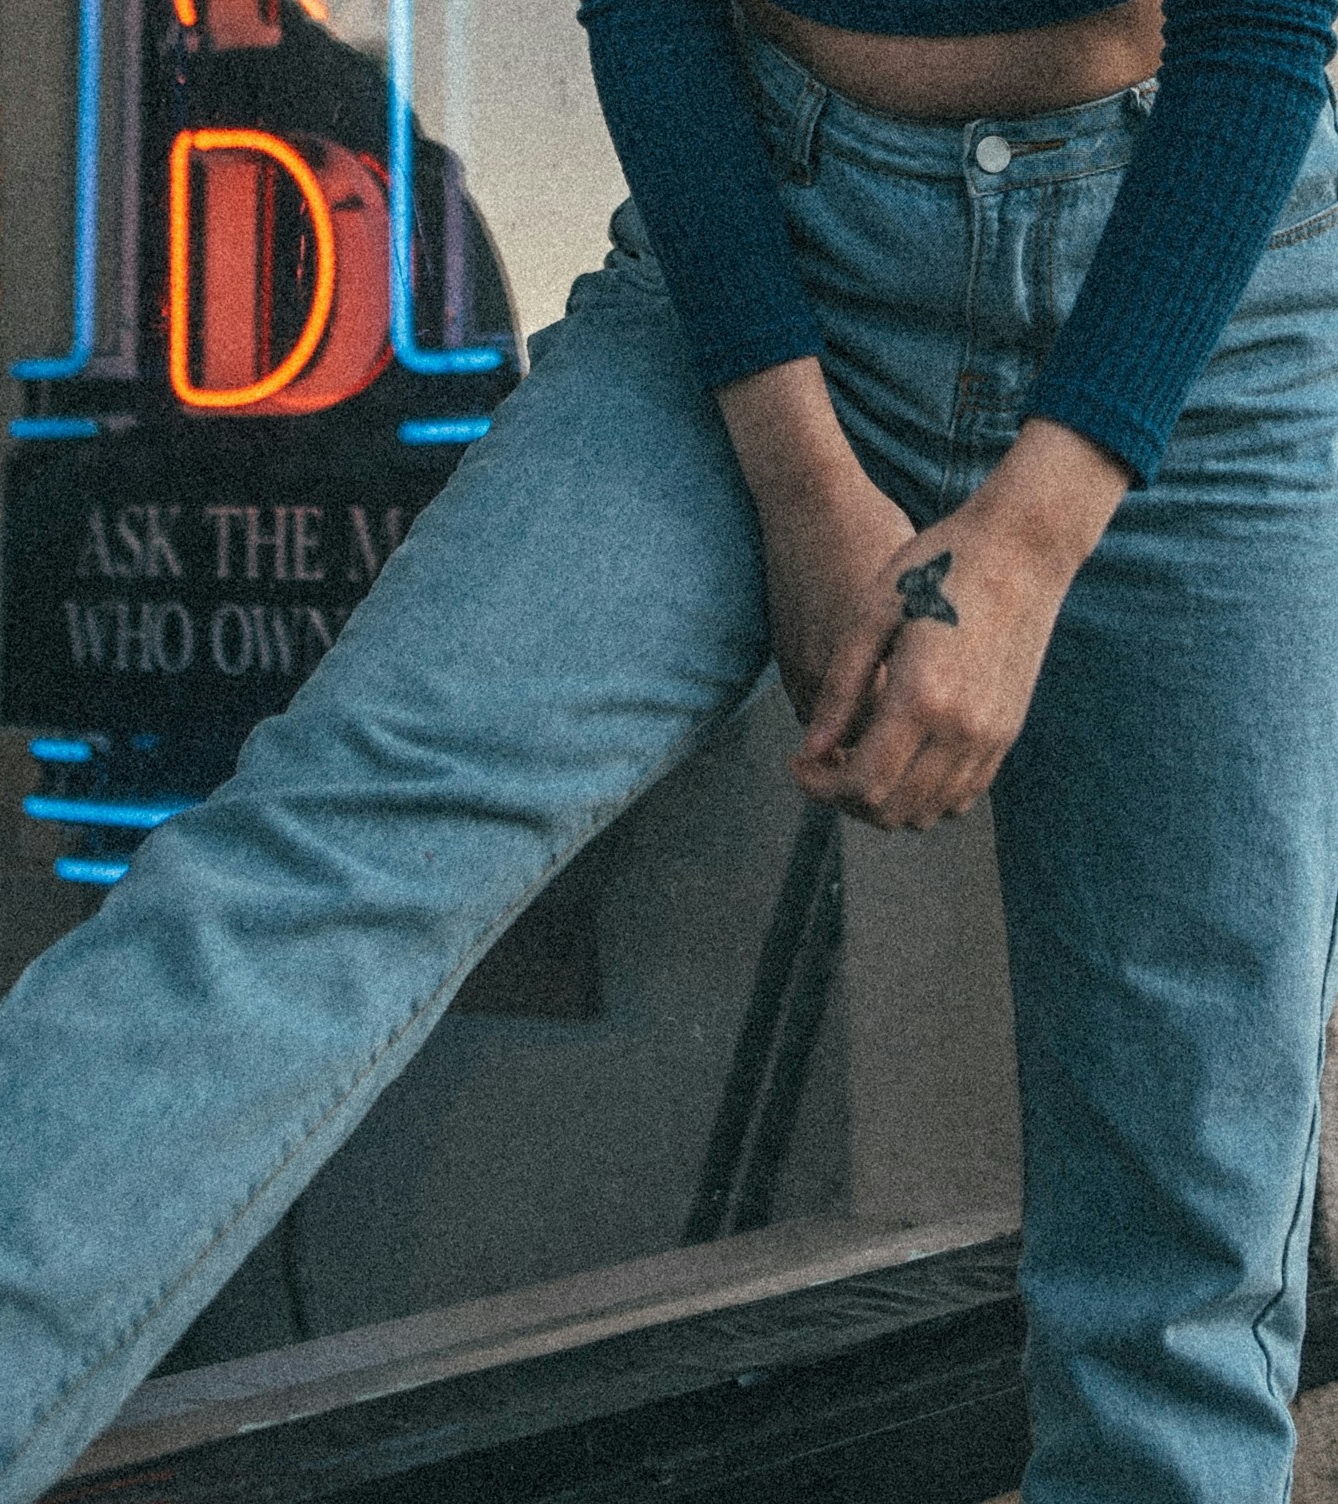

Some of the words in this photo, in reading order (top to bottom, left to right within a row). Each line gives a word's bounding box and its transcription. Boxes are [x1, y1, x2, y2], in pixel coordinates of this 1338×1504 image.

[74, 503, 185, 581] ASK
[204, 503, 325, 582] THE
[63, 601, 194, 674] WHO
